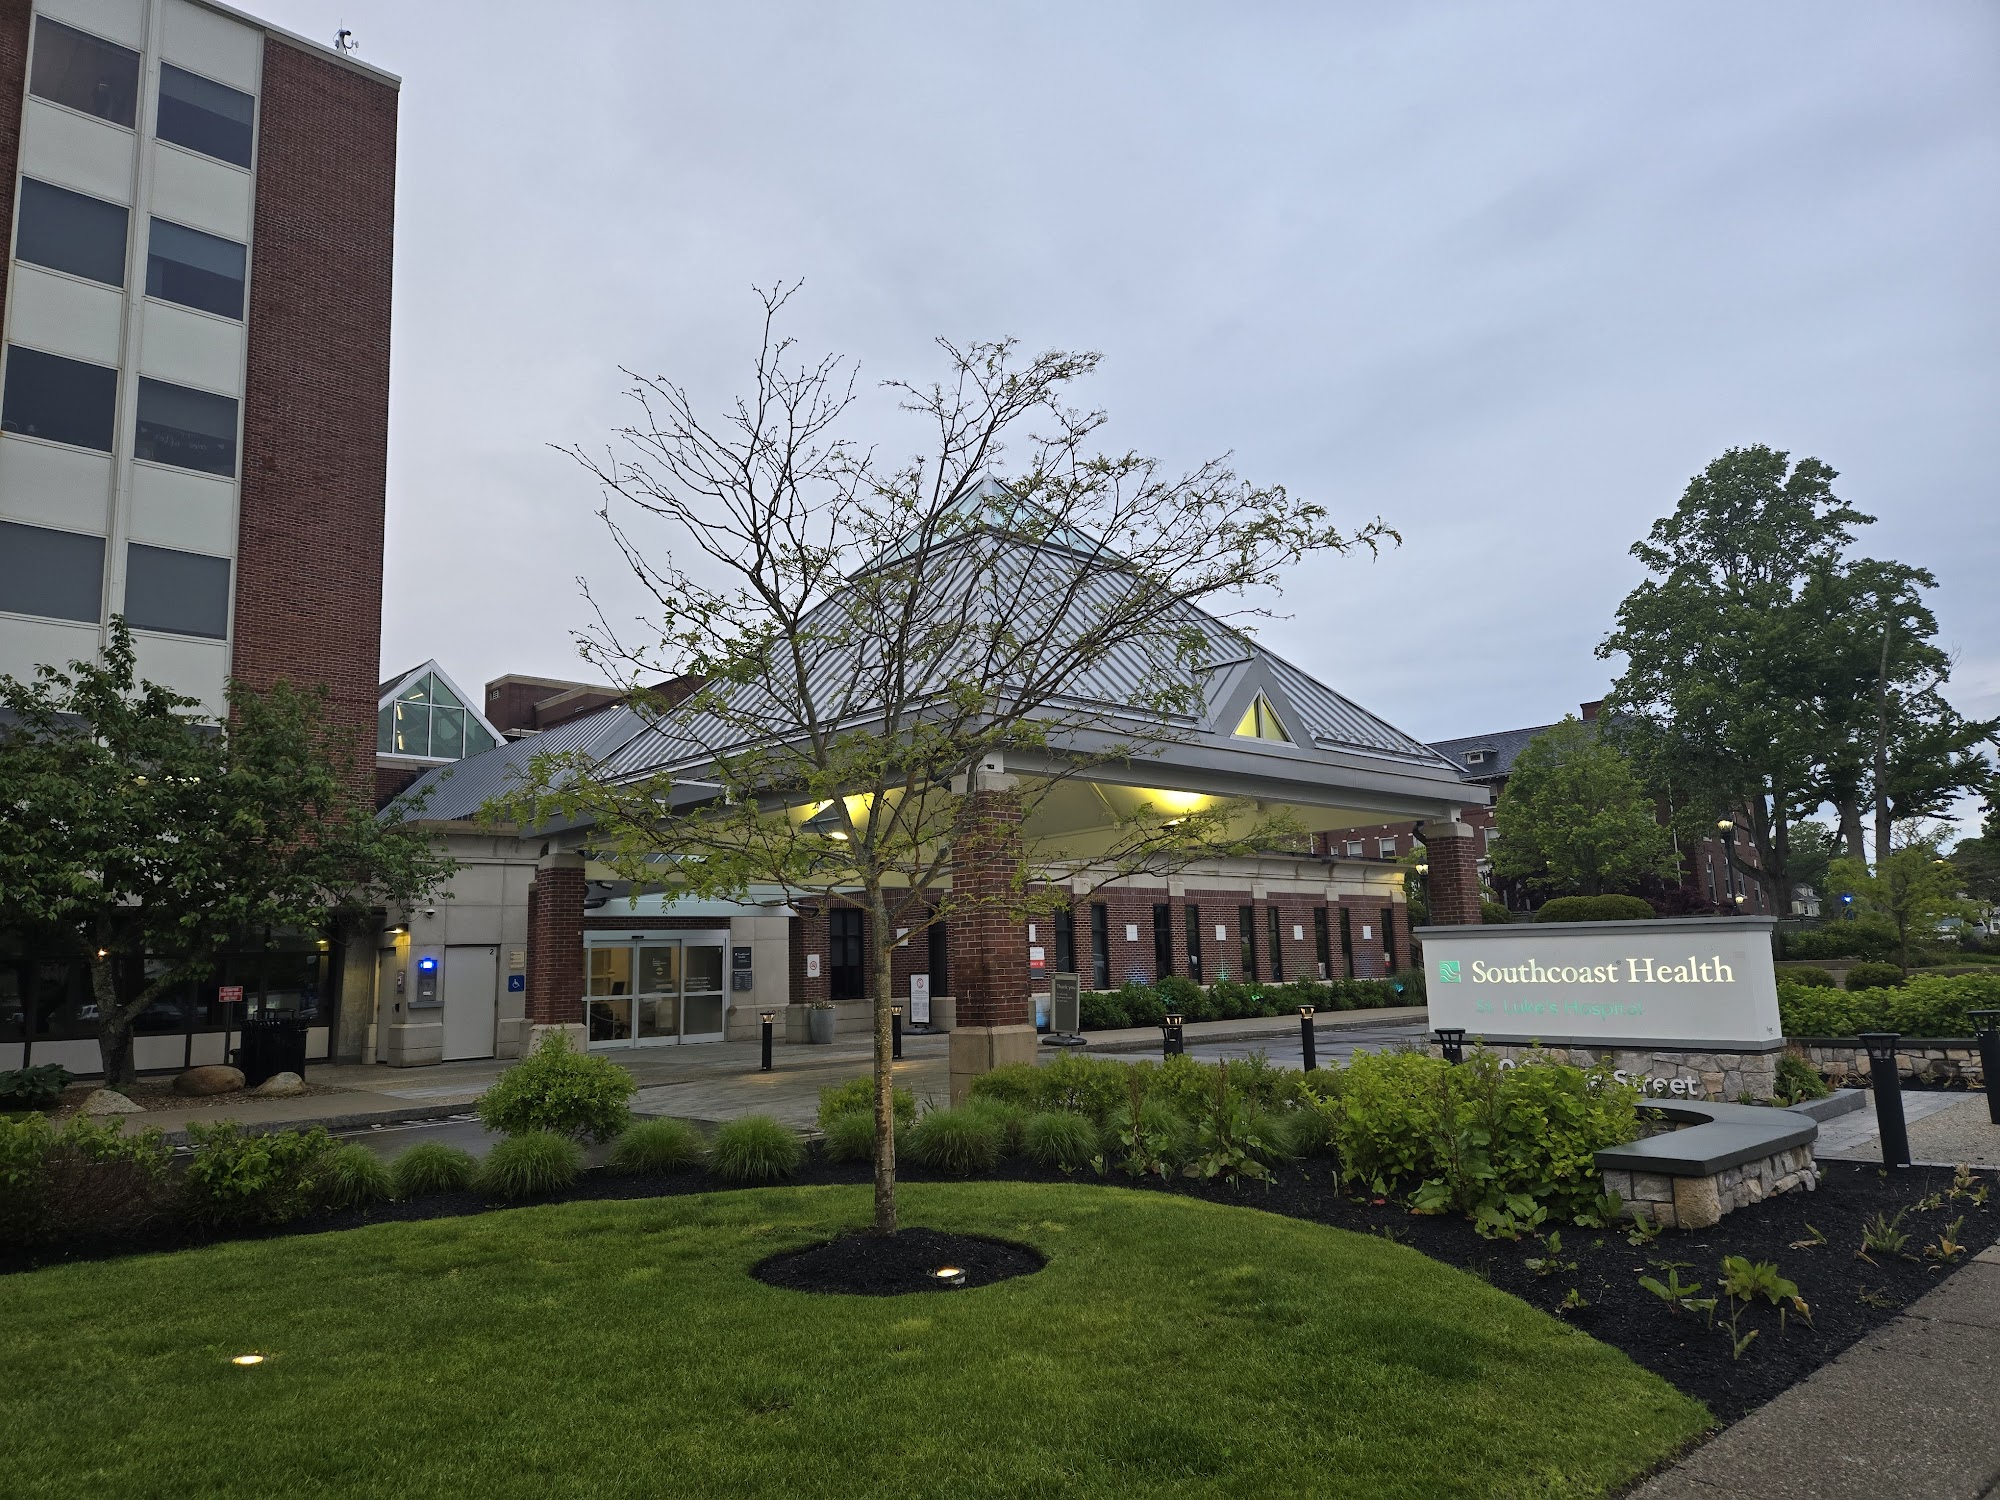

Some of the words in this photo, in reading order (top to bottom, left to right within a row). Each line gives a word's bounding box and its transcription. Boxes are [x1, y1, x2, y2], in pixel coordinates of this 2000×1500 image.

[1471, 958, 1619, 984] Southcoast
[1625, 955, 1736, 983] Health
[1503, 999, 1559, 1015] Luke's
[1564, 999, 1644, 1021] Hospital
